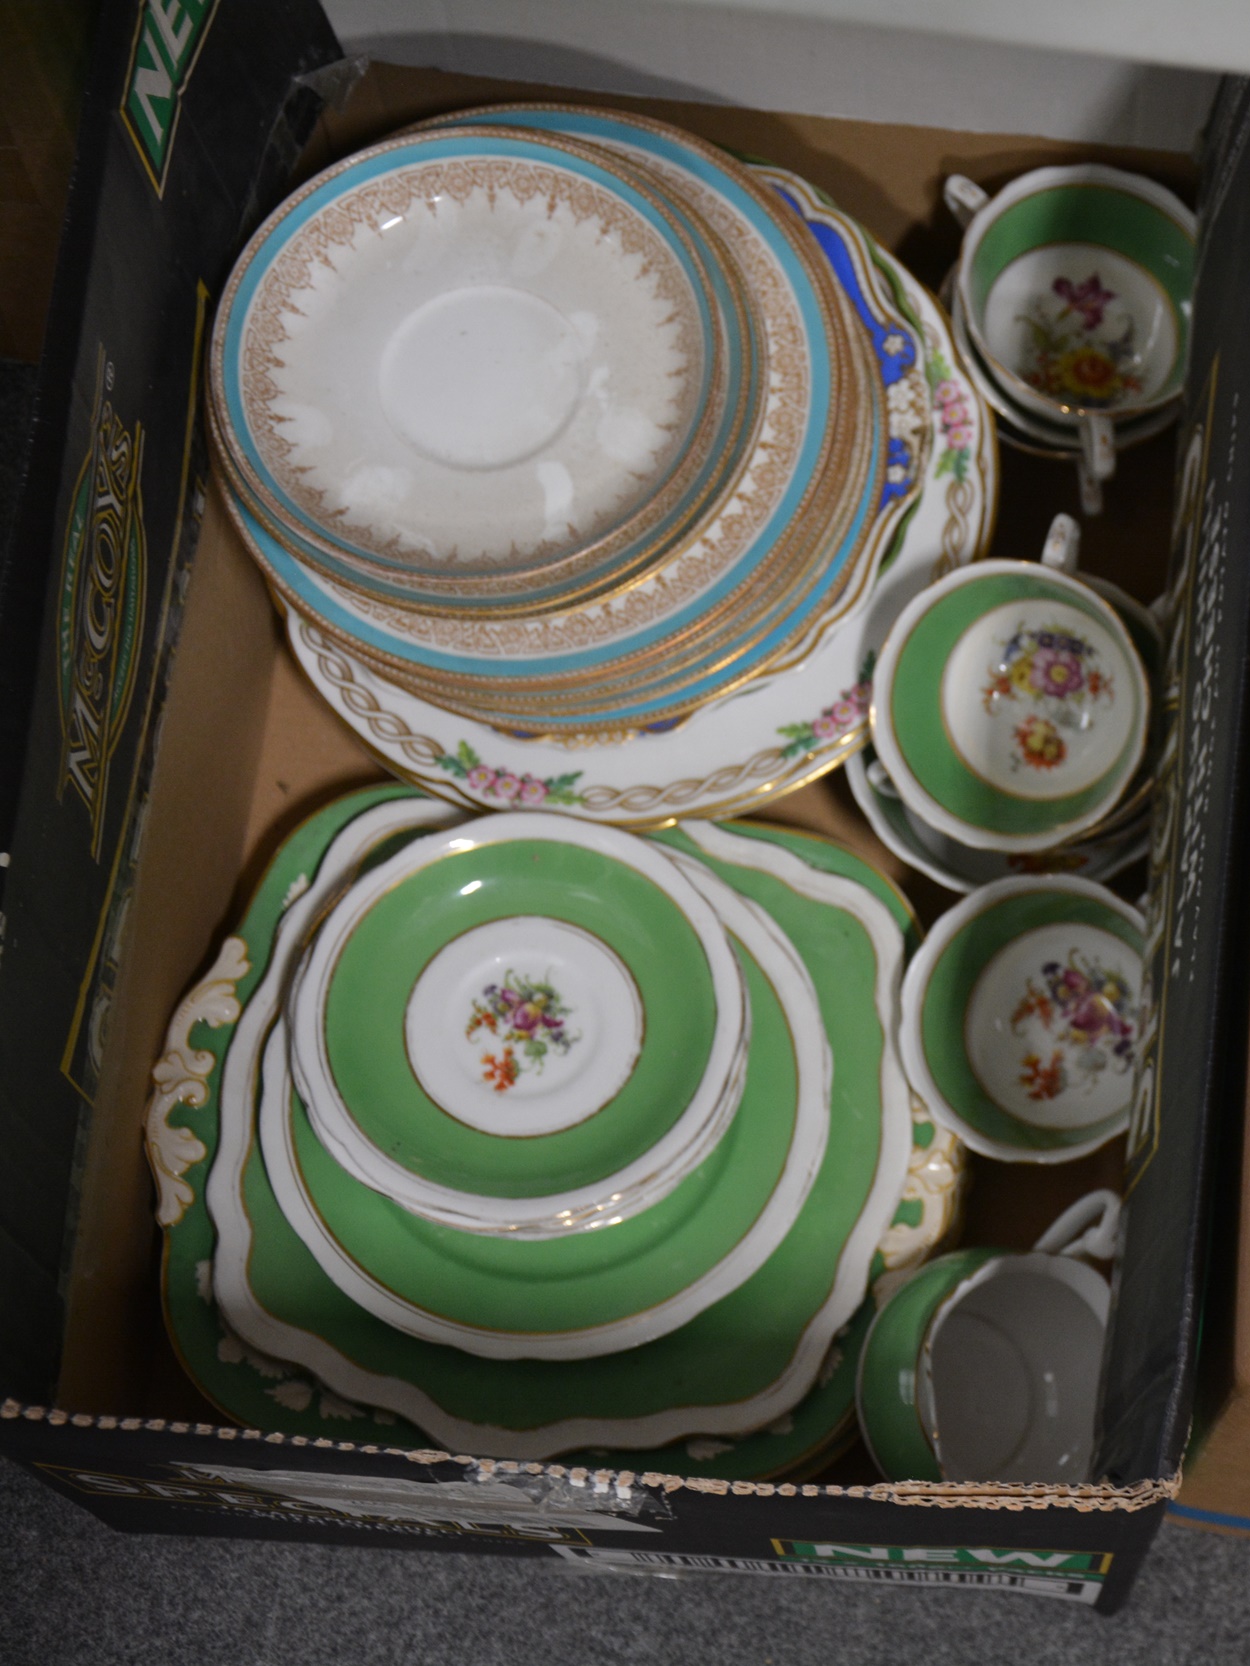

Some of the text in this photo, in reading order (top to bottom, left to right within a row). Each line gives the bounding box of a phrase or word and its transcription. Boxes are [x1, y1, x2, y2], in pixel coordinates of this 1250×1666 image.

[133, 0, 204, 146] NE
[65, 513, 84, 592] REAL
[813, 1544, 1075, 1568] NEW
